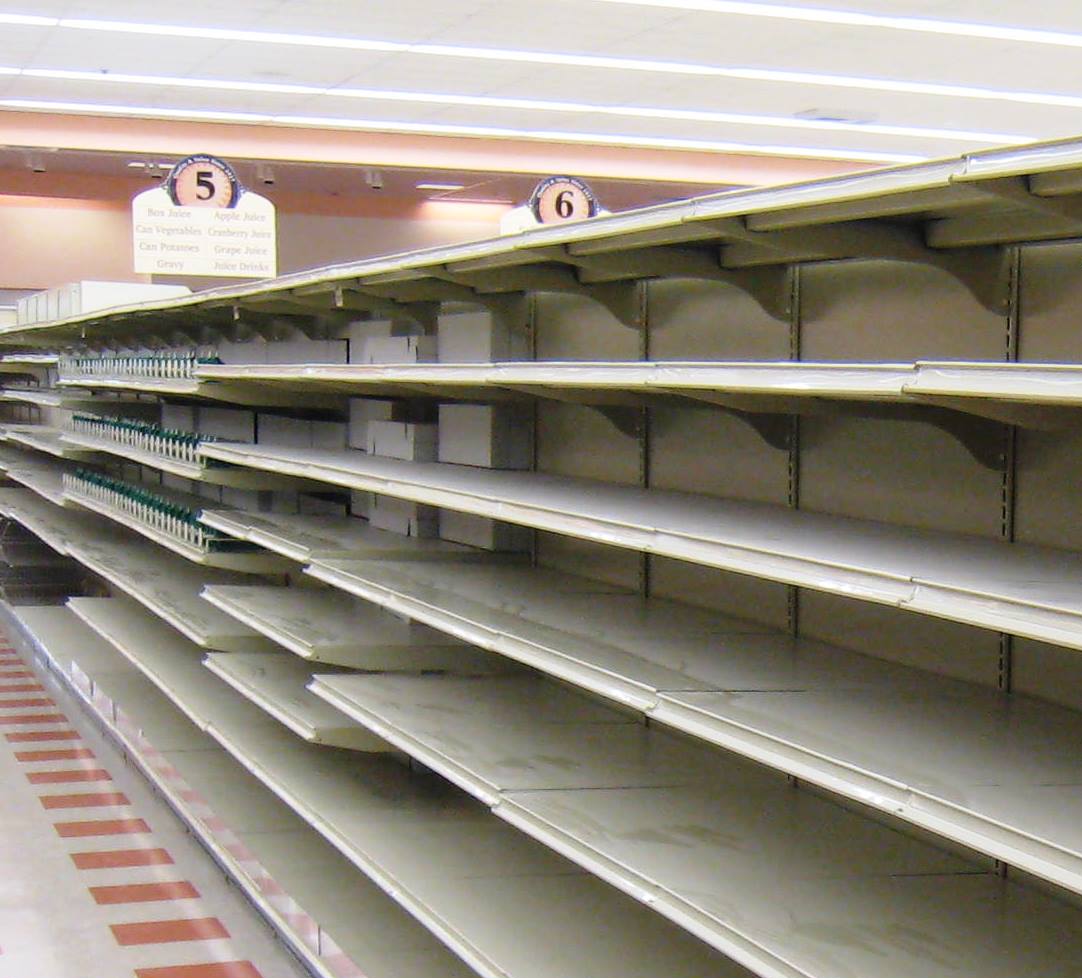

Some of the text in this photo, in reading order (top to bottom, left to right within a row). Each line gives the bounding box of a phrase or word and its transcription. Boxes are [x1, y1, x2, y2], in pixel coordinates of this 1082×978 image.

[196, 171, 216, 200] 5
[555, 190, 575, 219] 6
[147, 207, 192, 218] Box Juice
[214, 211, 267, 222] Apple Juice
[135, 224, 202, 236] Can Vegetables
[139, 241, 200, 253] Can Potatoes
[214, 246, 267, 257] Grape Juice
[156, 259, 184, 271] Gravy
[214, 262, 270, 273] Juice Drinks
